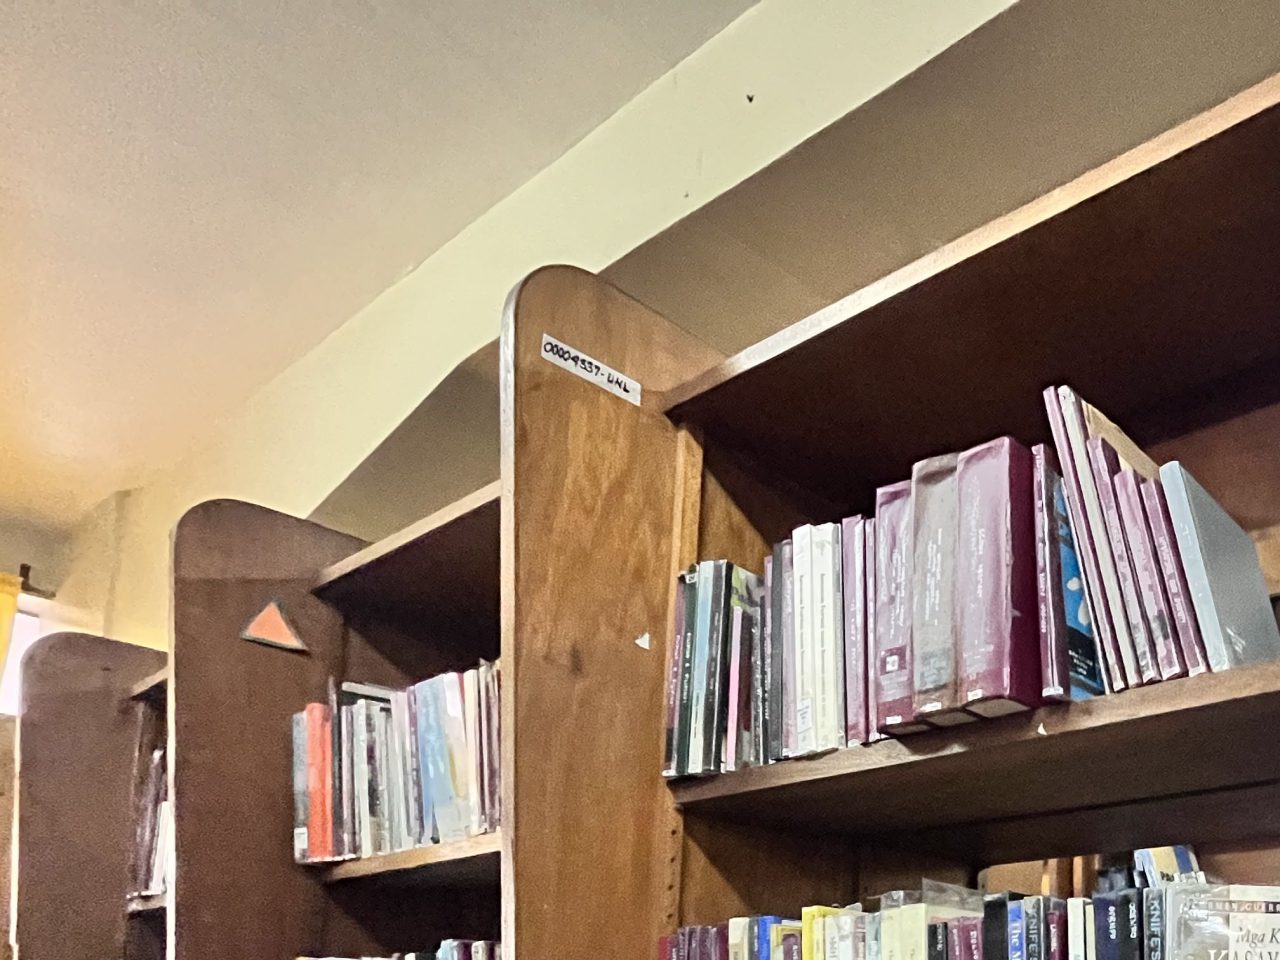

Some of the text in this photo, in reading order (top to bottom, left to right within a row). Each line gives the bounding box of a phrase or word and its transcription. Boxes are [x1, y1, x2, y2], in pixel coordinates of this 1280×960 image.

[1011, 921, 1022, 946] The
[1150, 900, 1161, 960] KNIFE'S
[1236, 927, 1265, 948] Mga
